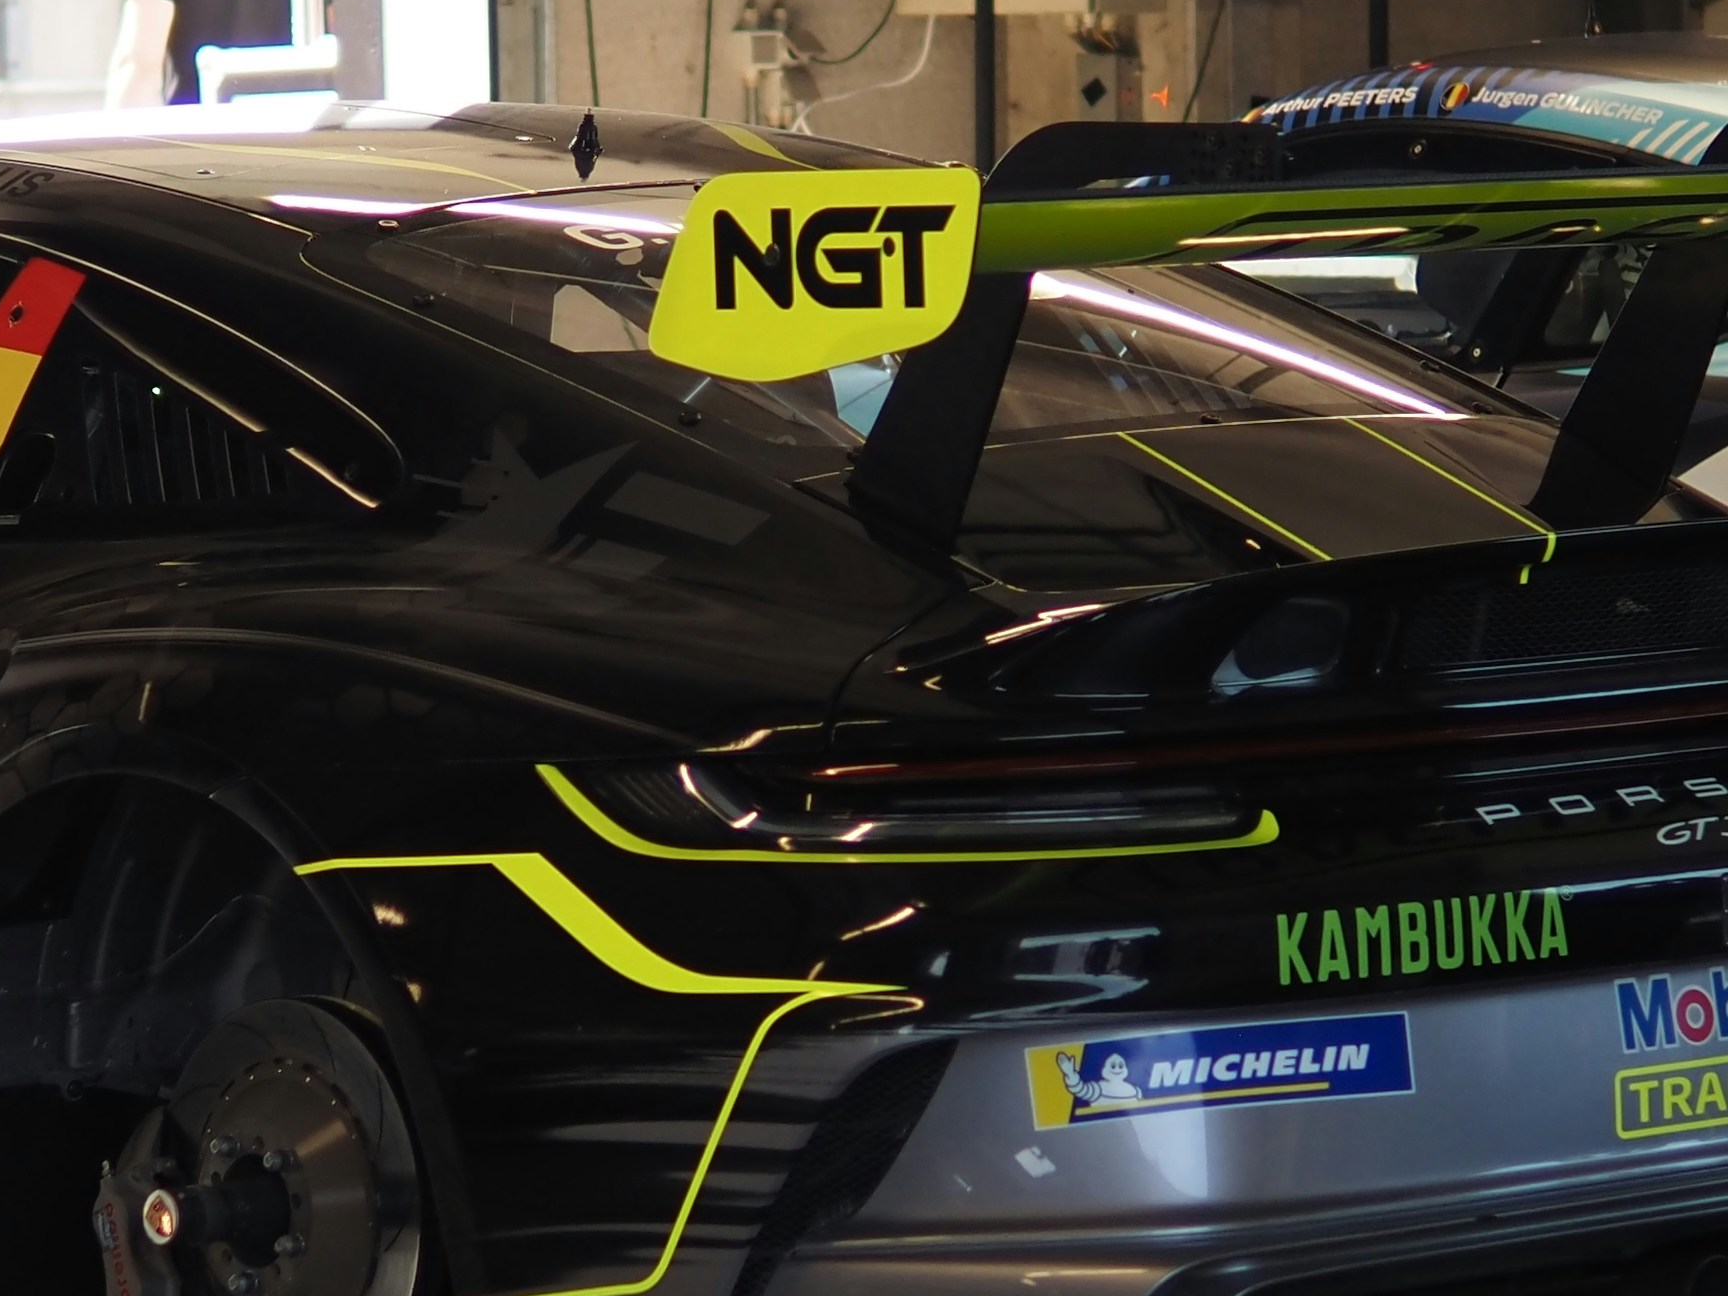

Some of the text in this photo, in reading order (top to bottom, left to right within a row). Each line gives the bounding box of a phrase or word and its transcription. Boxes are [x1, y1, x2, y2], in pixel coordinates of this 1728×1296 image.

[1262, 87, 1418, 116] Arthur PEETERS
[1472, 86, 1664, 124] Jurgen GULINCHER
[713, 205, 956, 310] NGT
[1148, 1044, 1370, 1088] MICHELIN
